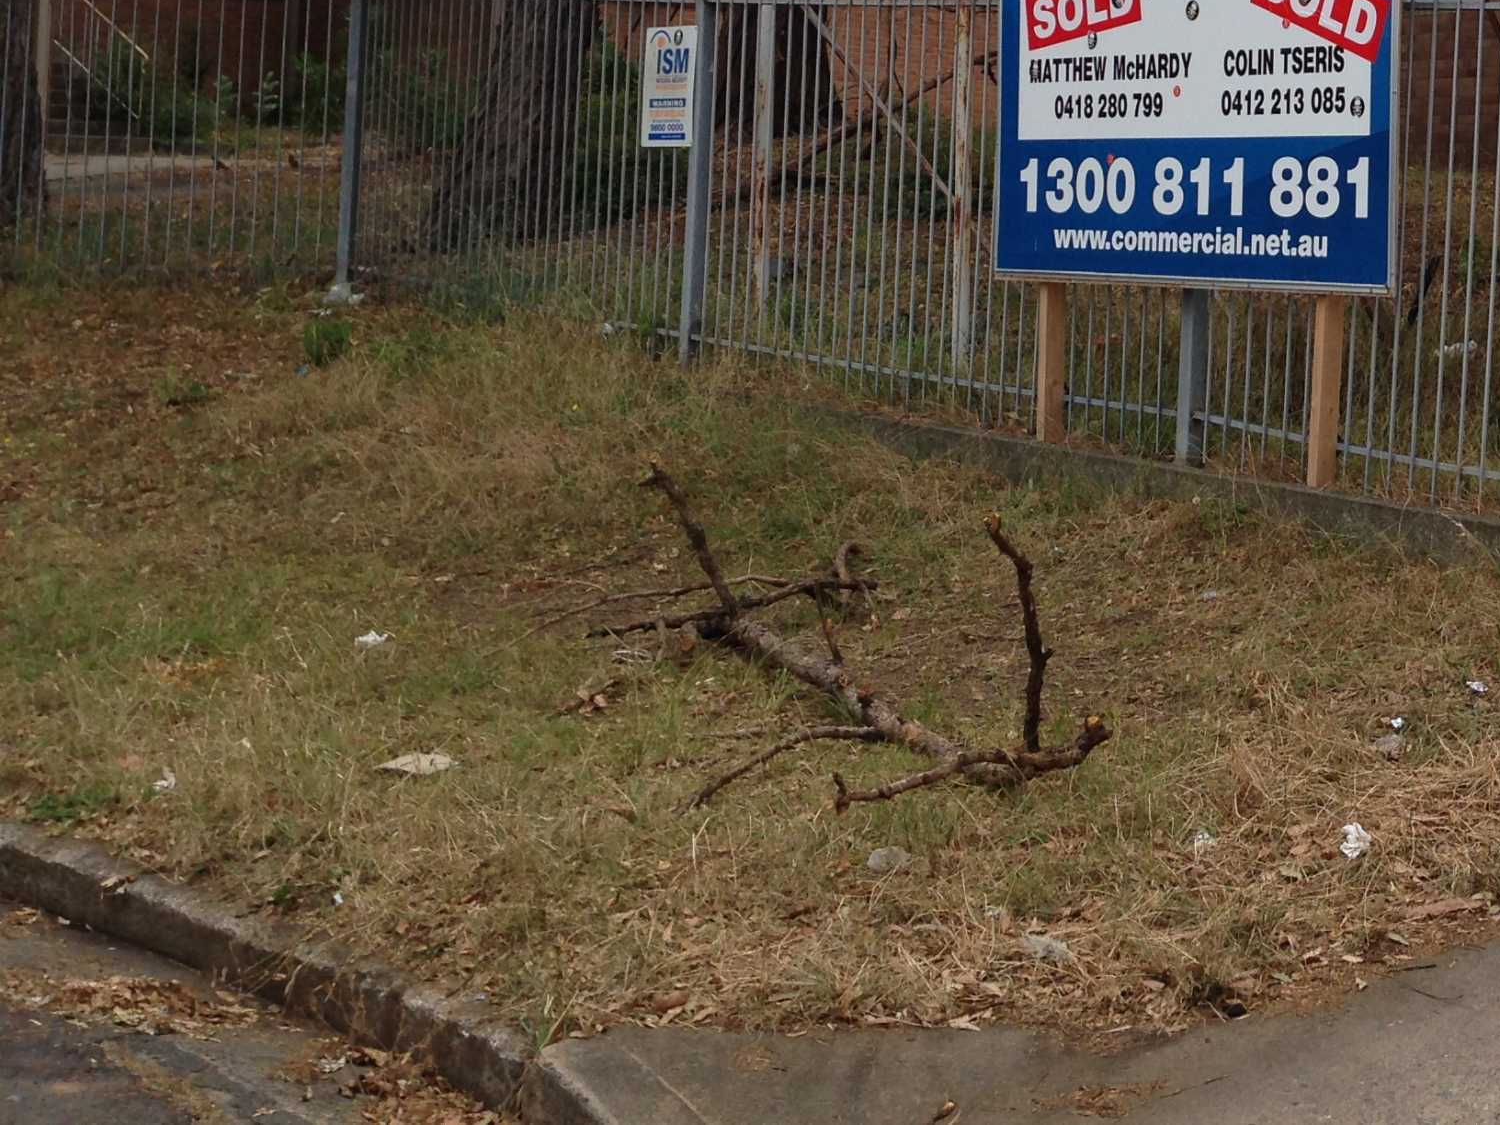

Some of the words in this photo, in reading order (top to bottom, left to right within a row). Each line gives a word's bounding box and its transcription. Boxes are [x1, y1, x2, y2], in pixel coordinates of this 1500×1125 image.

[656, 48, 690, 74] ISM
[1029, 56, 1106, 84] MATTHEW
[1113, 52, 1192, 81] McHARDY
[1223, 49, 1274, 77] COLIN
[1280, 45, 1345, 74] TSERIS
[1054, 95, 1093, 120] 0418
[1098, 93, 1128, 118] 280
[1133, 92, 1163, 117] 799
[1221, 90, 1264, 117] 0412
[1270, 88, 1303, 115] 213
[1310, 86, 1346, 114] 085
[1020, 157, 1136, 215] 1300
[1152, 156, 1244, 217] 811
[1269, 156, 1370, 219] 881
[1054, 226, 1328, 258] www.commercial.net.au
